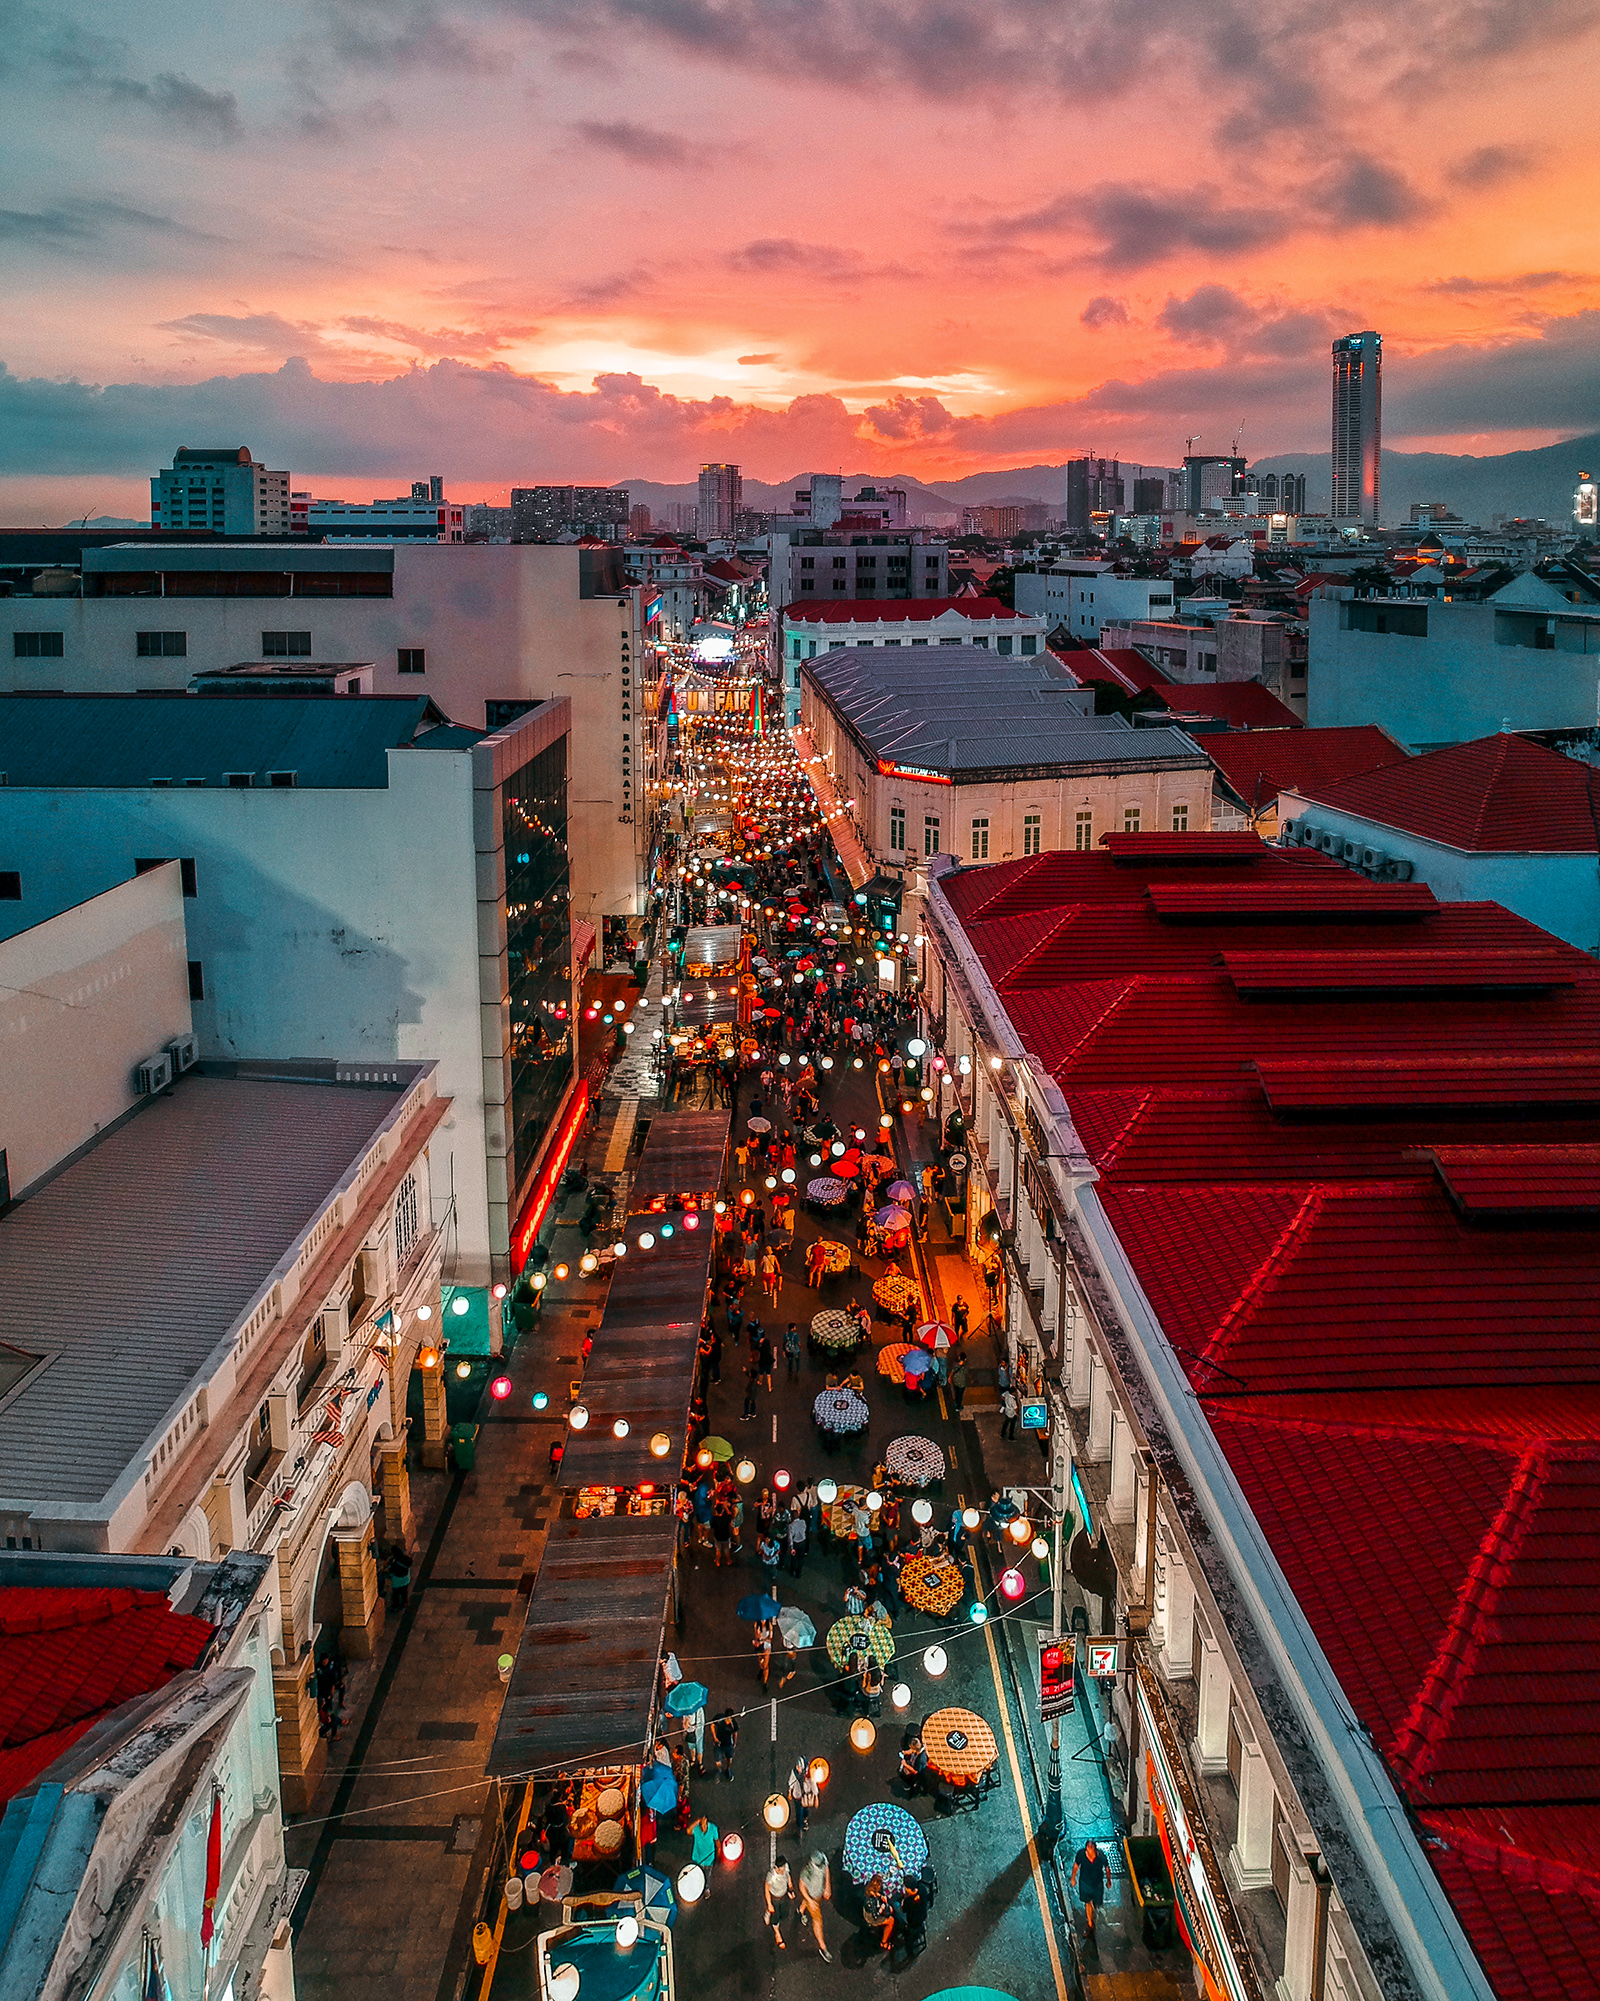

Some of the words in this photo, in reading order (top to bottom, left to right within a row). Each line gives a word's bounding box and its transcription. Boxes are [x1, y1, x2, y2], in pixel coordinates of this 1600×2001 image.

[621, 631, 631, 721] BANGUNAN
[676, 691, 709, 711] FUN
[715, 691, 750, 711] FAIR
[622, 733, 631, 811] BARKATH
